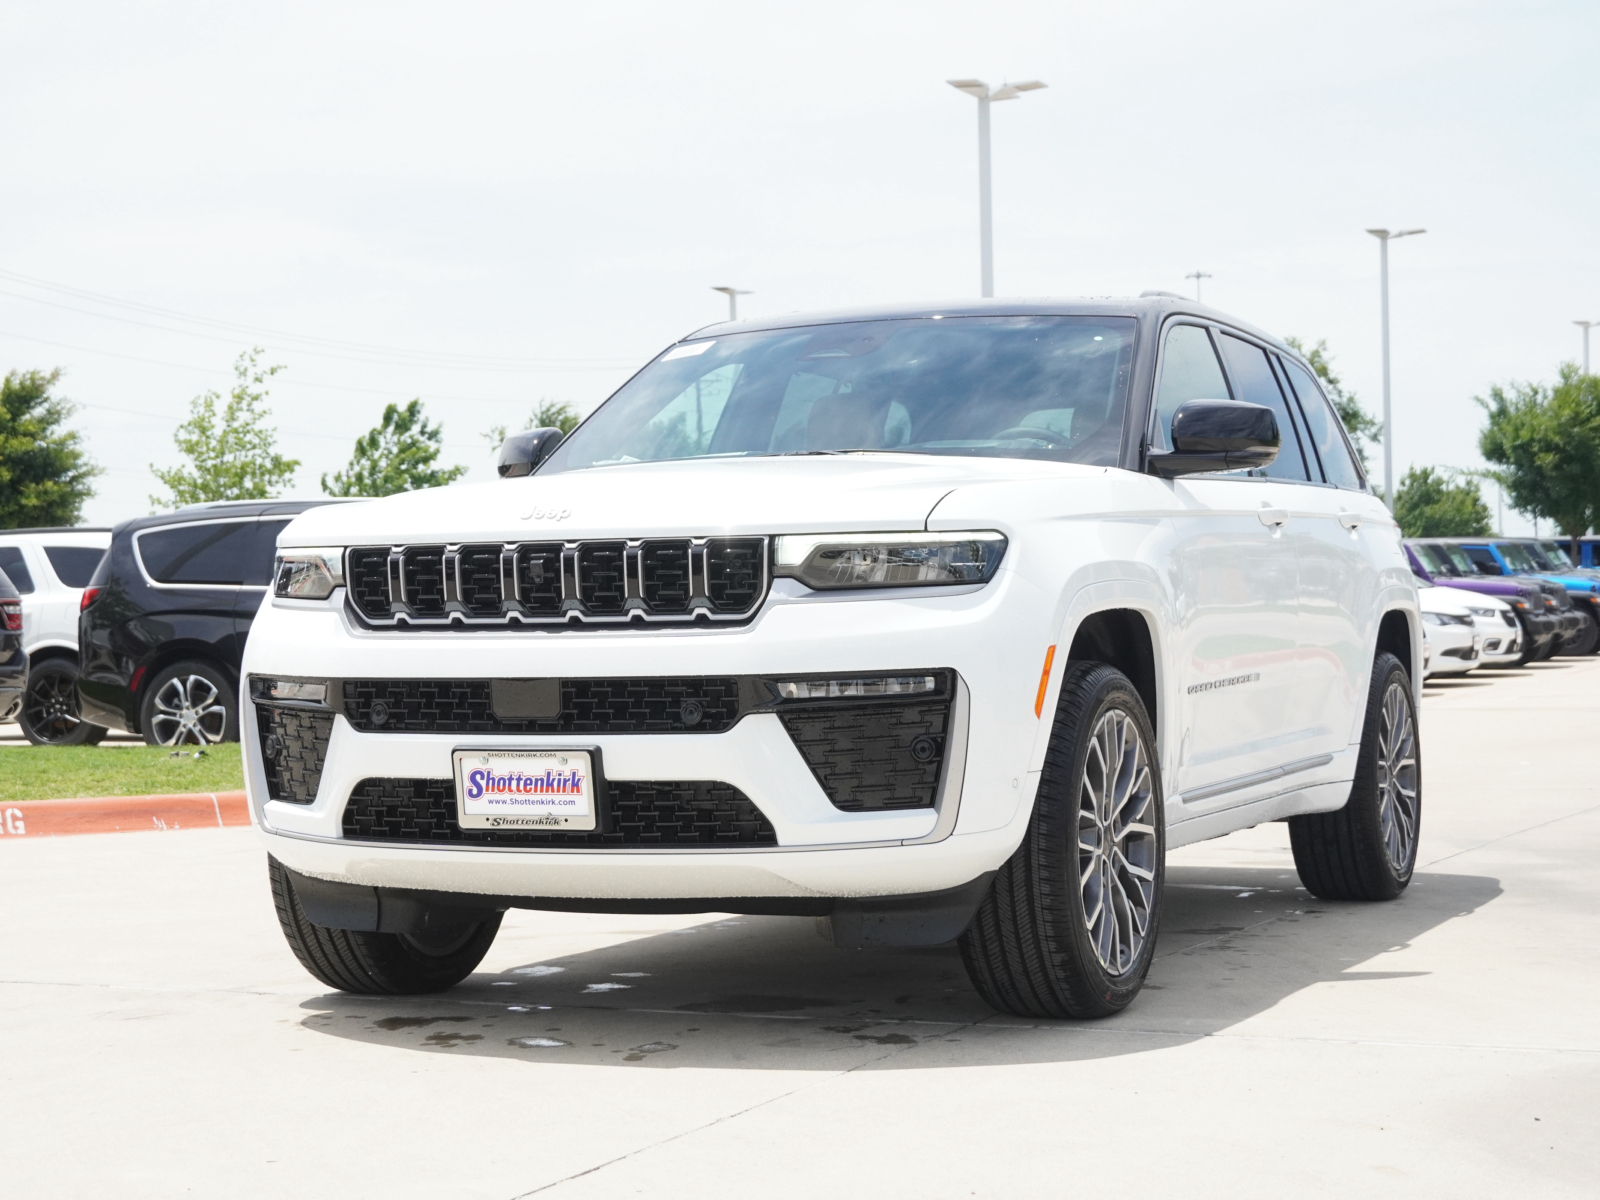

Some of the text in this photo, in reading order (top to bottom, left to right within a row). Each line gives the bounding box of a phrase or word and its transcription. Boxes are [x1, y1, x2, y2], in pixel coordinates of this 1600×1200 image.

[520, 505, 572, 521] Jeep
[467, 769, 584, 799] Shottenkirk
[487, 798, 576, 806] www.Shottenkirk.com
[0, 808, 26, 834] G
[490, 815, 562, 827] Shottenkirk
